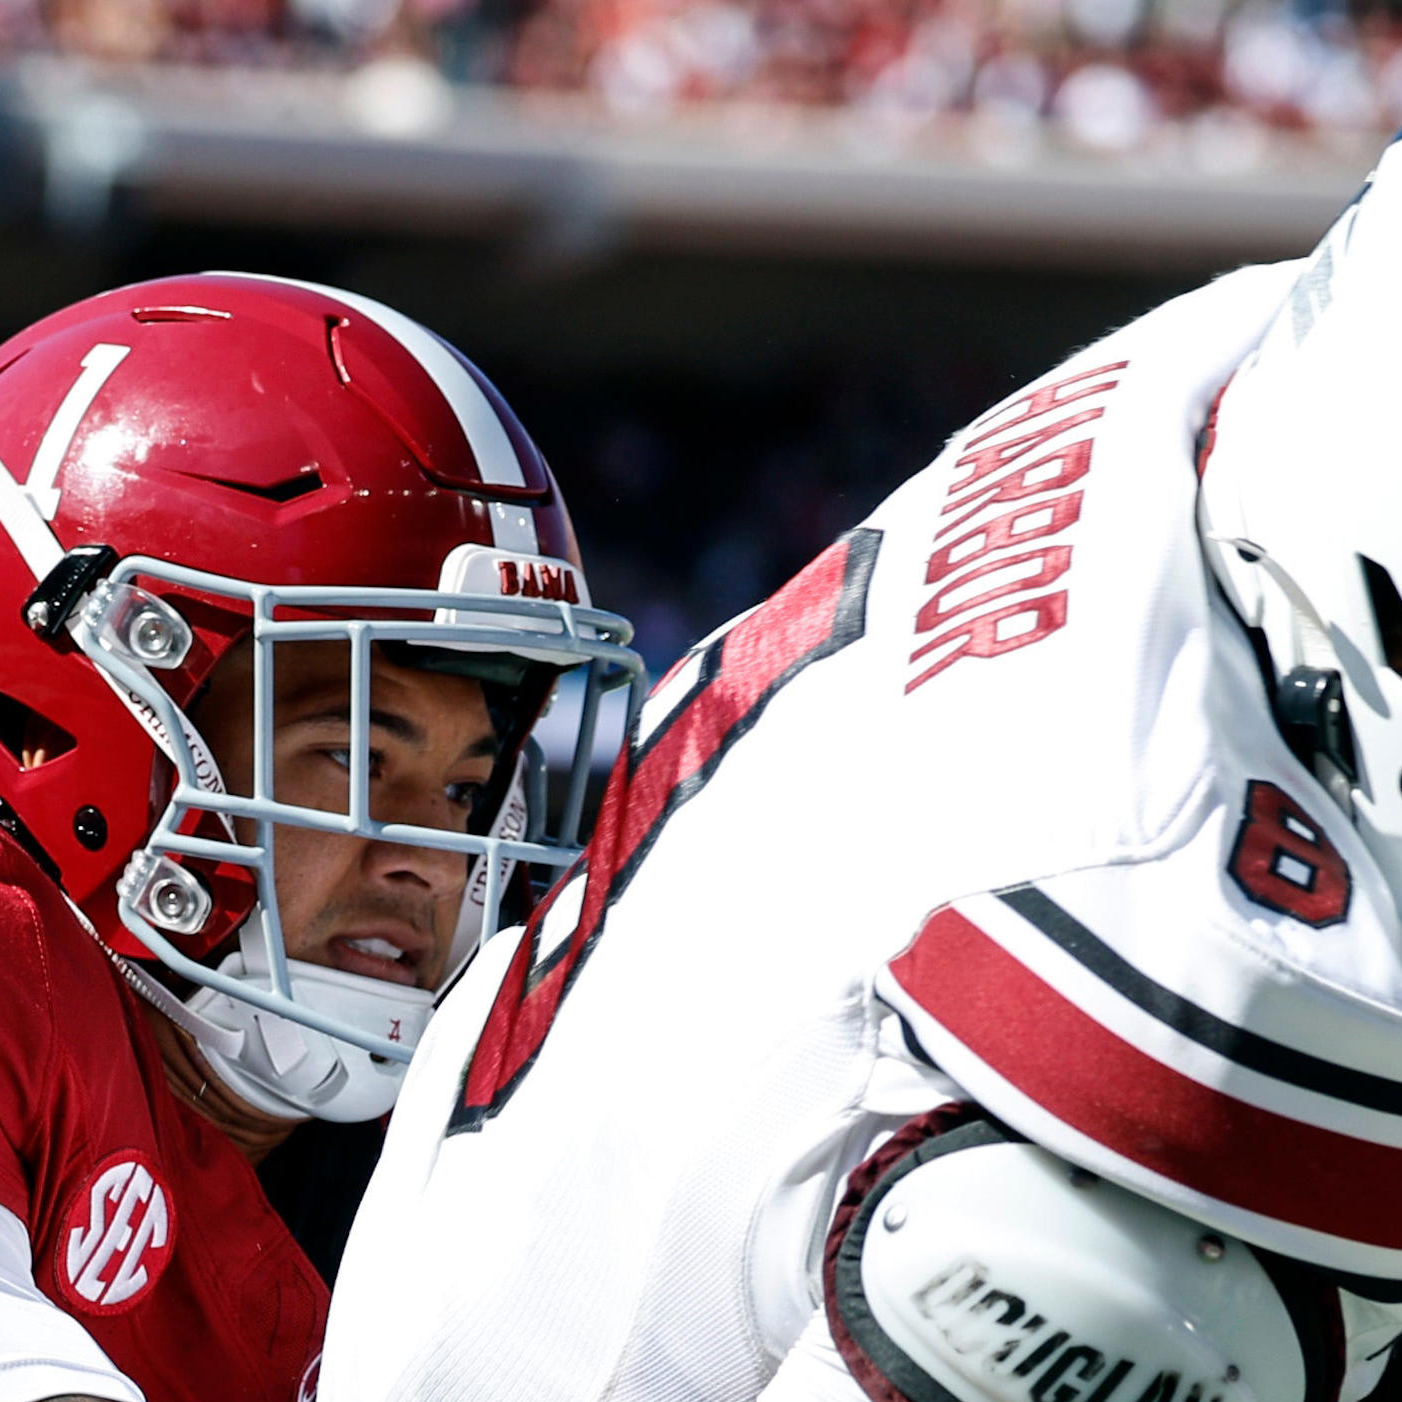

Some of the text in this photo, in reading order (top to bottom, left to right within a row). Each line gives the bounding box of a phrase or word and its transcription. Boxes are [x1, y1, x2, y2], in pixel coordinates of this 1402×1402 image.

[16, 343, 131, 521] 1
[499, 561, 580, 605] BAMA
[904, 360, 1130, 696] HARBOR
[128, 690, 224, 795] CRISON
[1226, 778, 1354, 930] 8
[67, 1162, 168, 1305] SEC
